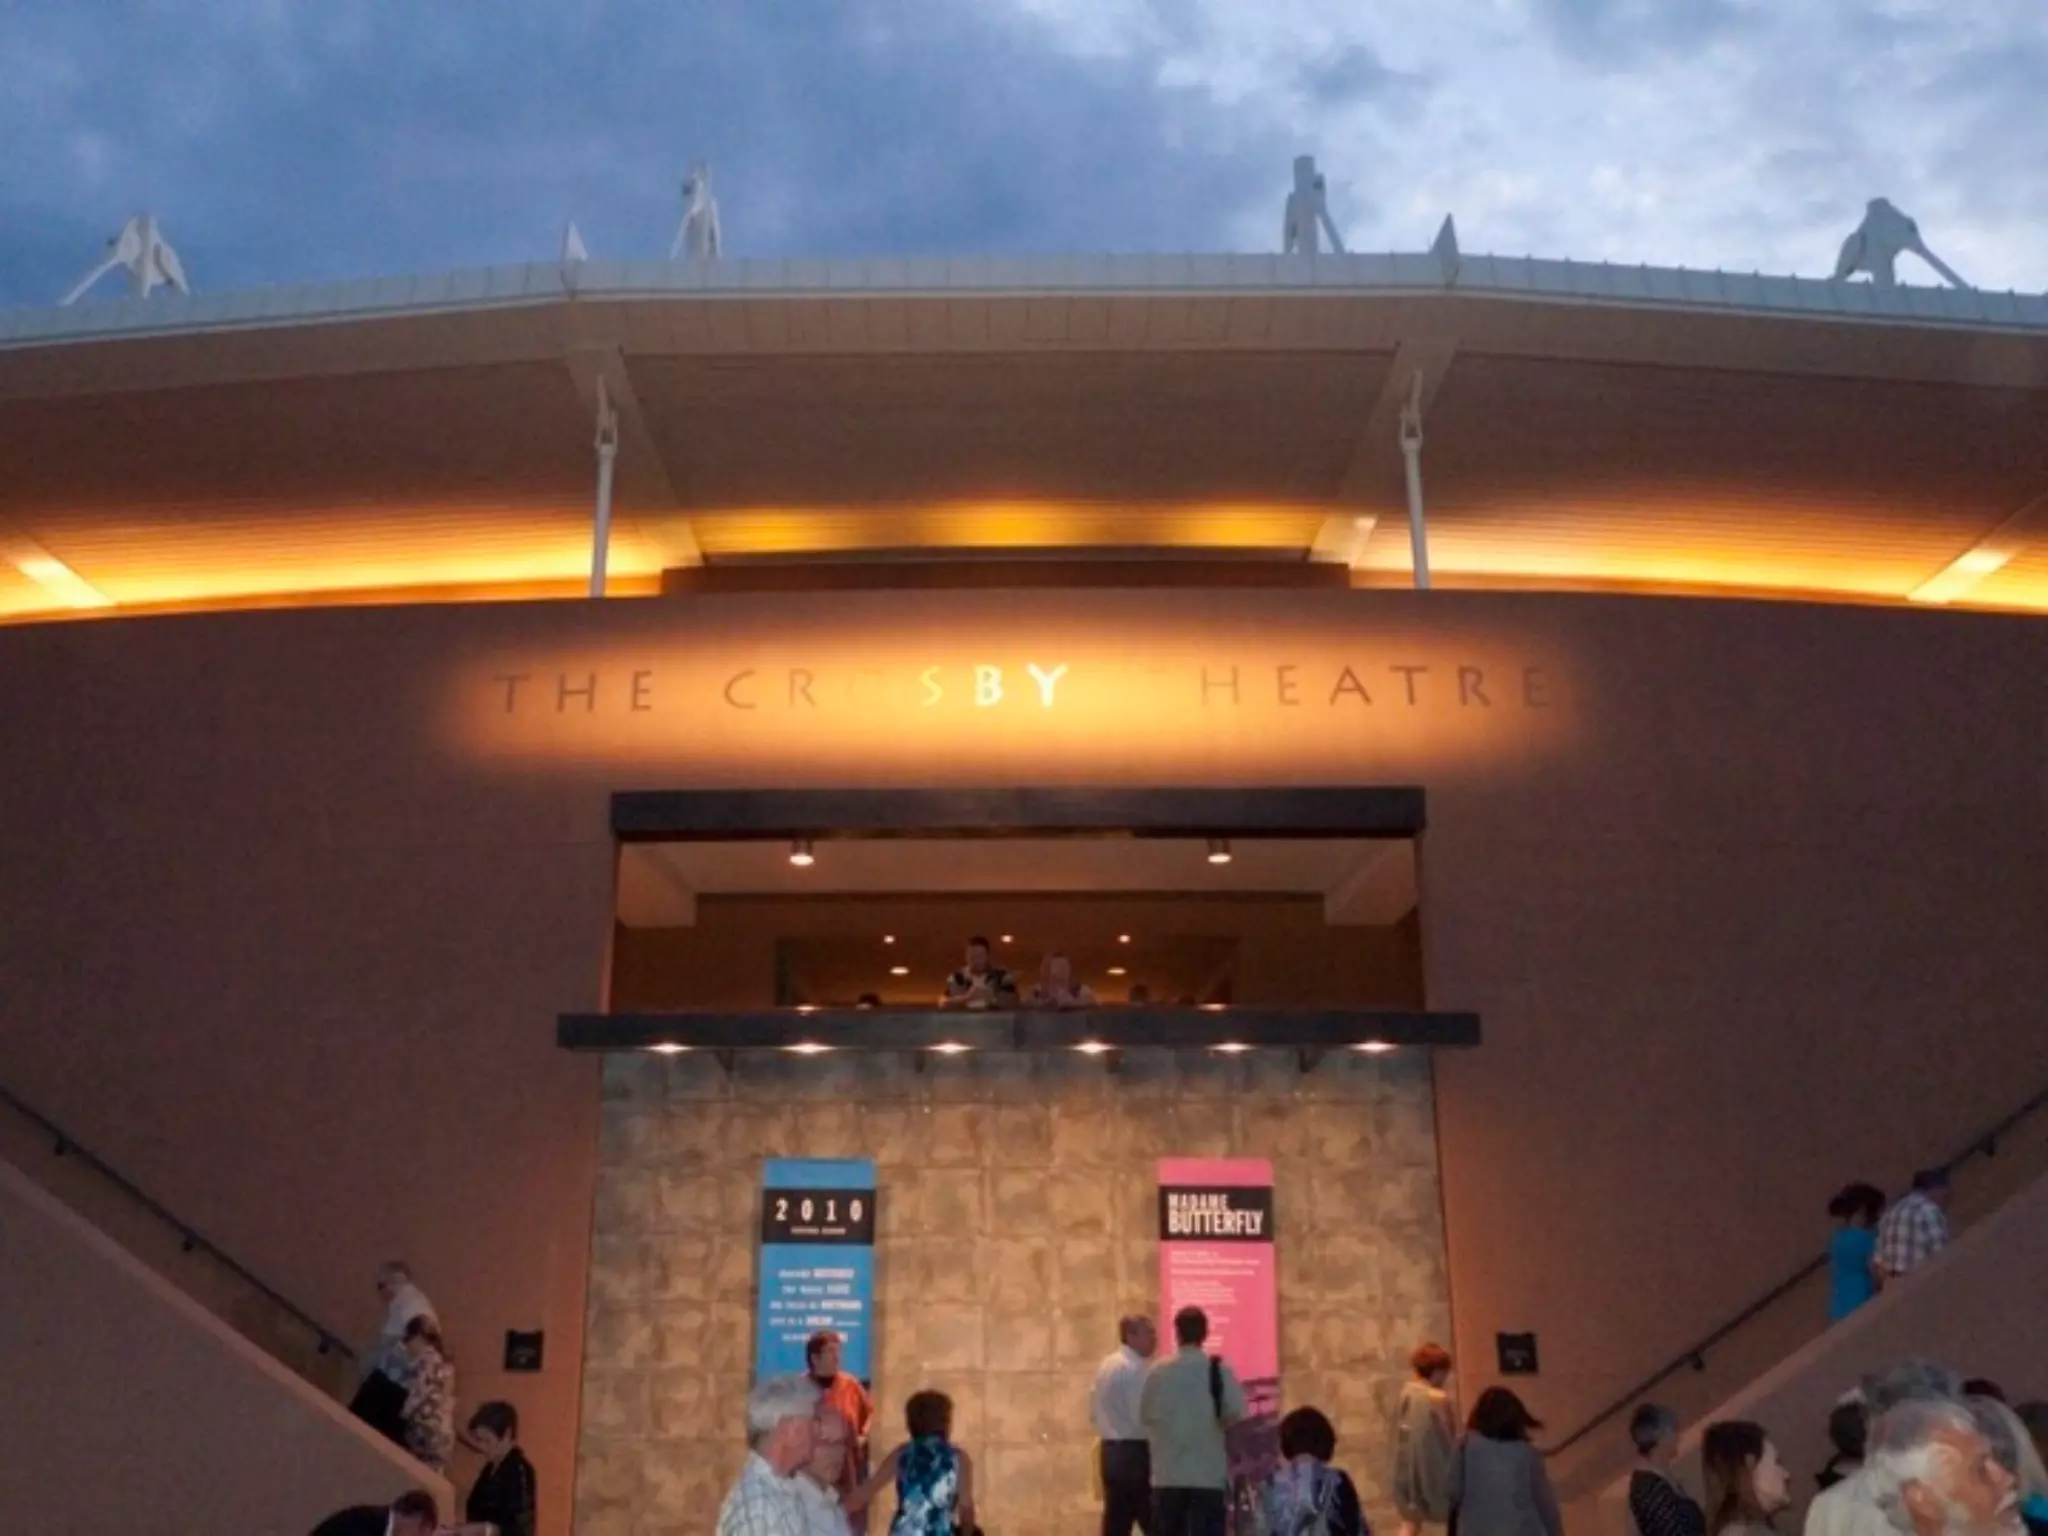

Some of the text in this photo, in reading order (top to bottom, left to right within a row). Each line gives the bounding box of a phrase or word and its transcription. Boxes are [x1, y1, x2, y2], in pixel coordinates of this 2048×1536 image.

[494, 669, 652, 714] THE
[1145, 665, 1551, 707] HEATRE
[775, 1197, 863, 1222] 2010
[1168, 1209, 1264, 1235] BUTTERFLY
